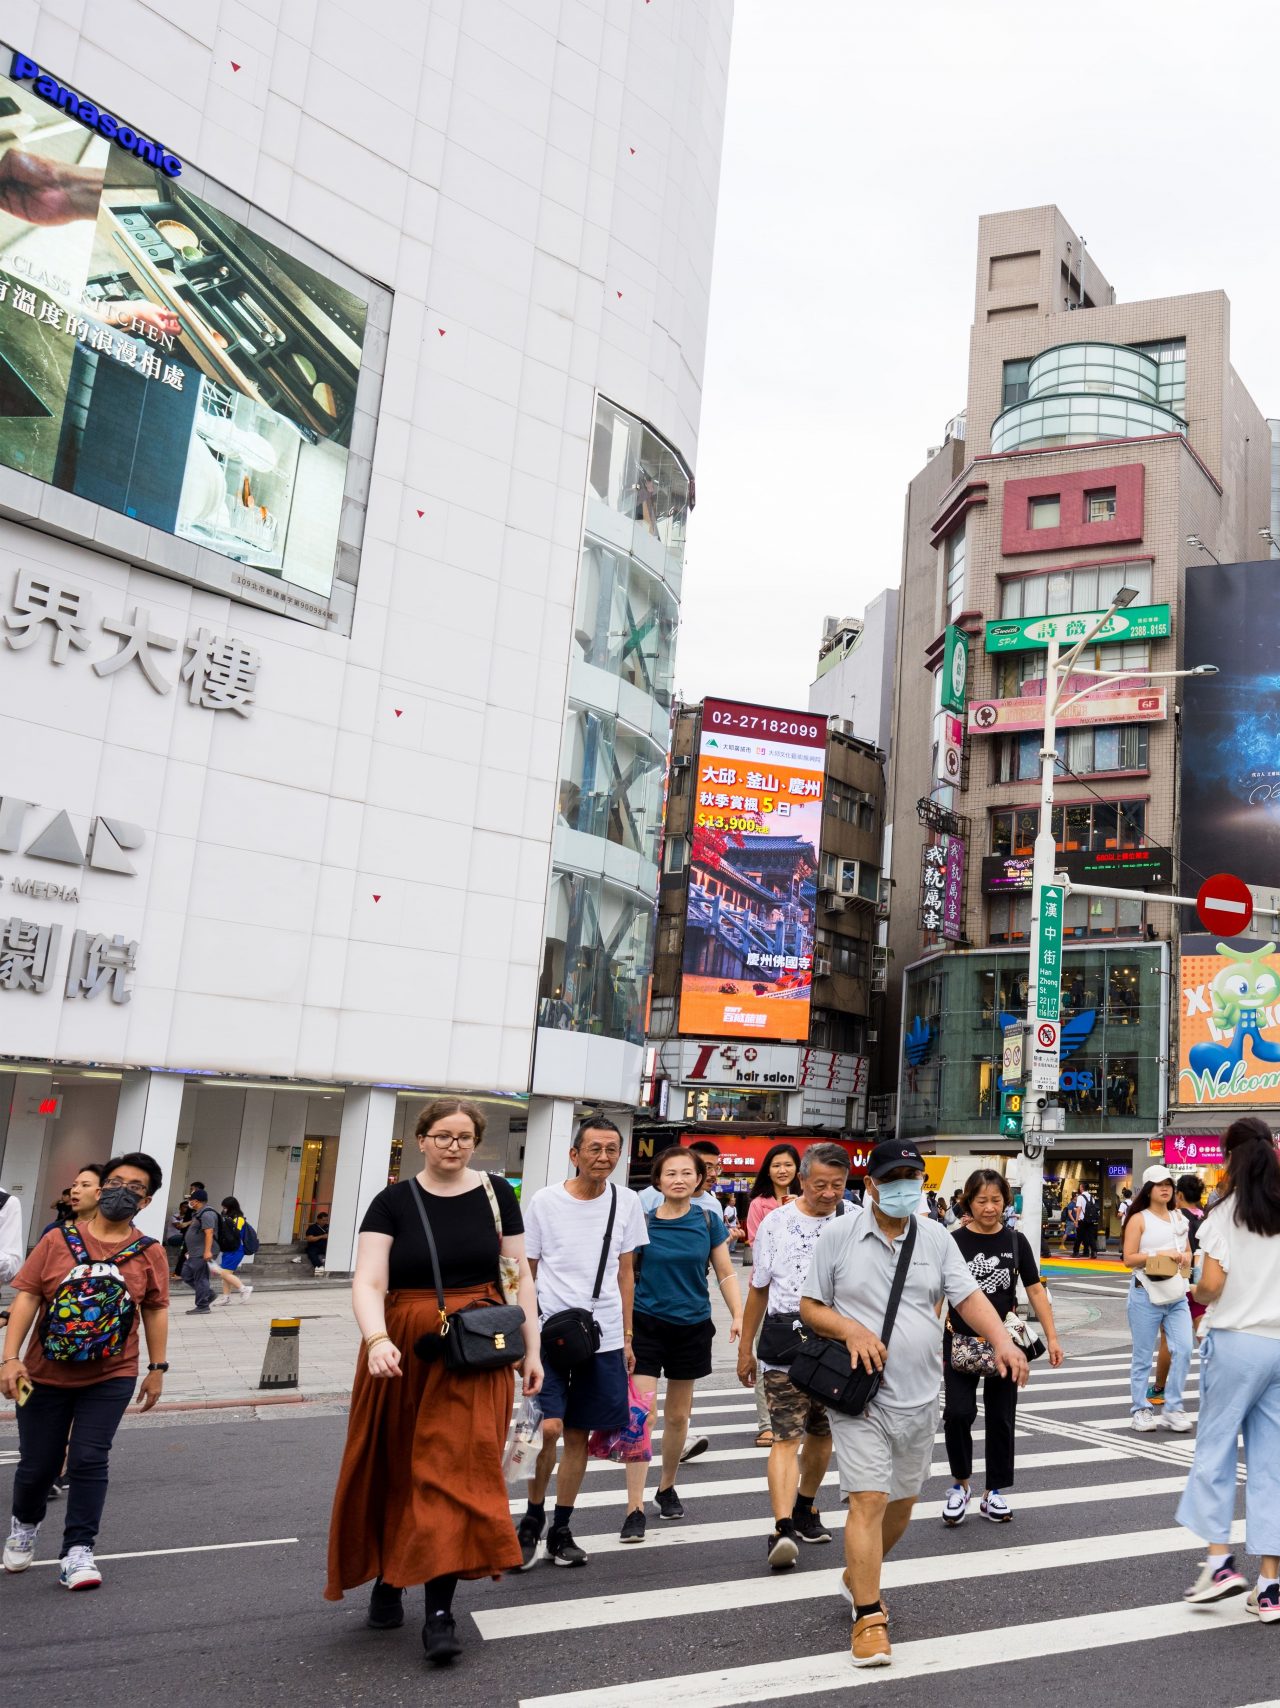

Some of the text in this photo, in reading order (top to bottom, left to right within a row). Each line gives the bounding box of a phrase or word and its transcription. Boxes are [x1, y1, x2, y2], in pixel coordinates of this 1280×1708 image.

[10, 53, 182, 178] Panasonic
[80, 292, 175, 352] KITCHEN
[1130, 623, 1167, 637] 2388-8155
[3, 567, 262, 720] 界大樓
[998, 637, 1018, 647] SPA
[1141, 700, 1155, 709] 6F
[711, 711, 818, 738] 02-27182099
[11, 876, 81, 904] MEDIA
[1043, 902, 1058, 966] 漢中街
[0, 917, 139, 1005] 劇院
[1039, 968, 1052, 976] Han
[1039, 977, 1058, 988] Zhong
[1039, 986, 1047, 994] St.
[736, 1069, 795, 1083] hair salon
[1108, 1165, 1127, 1175] OPEN
